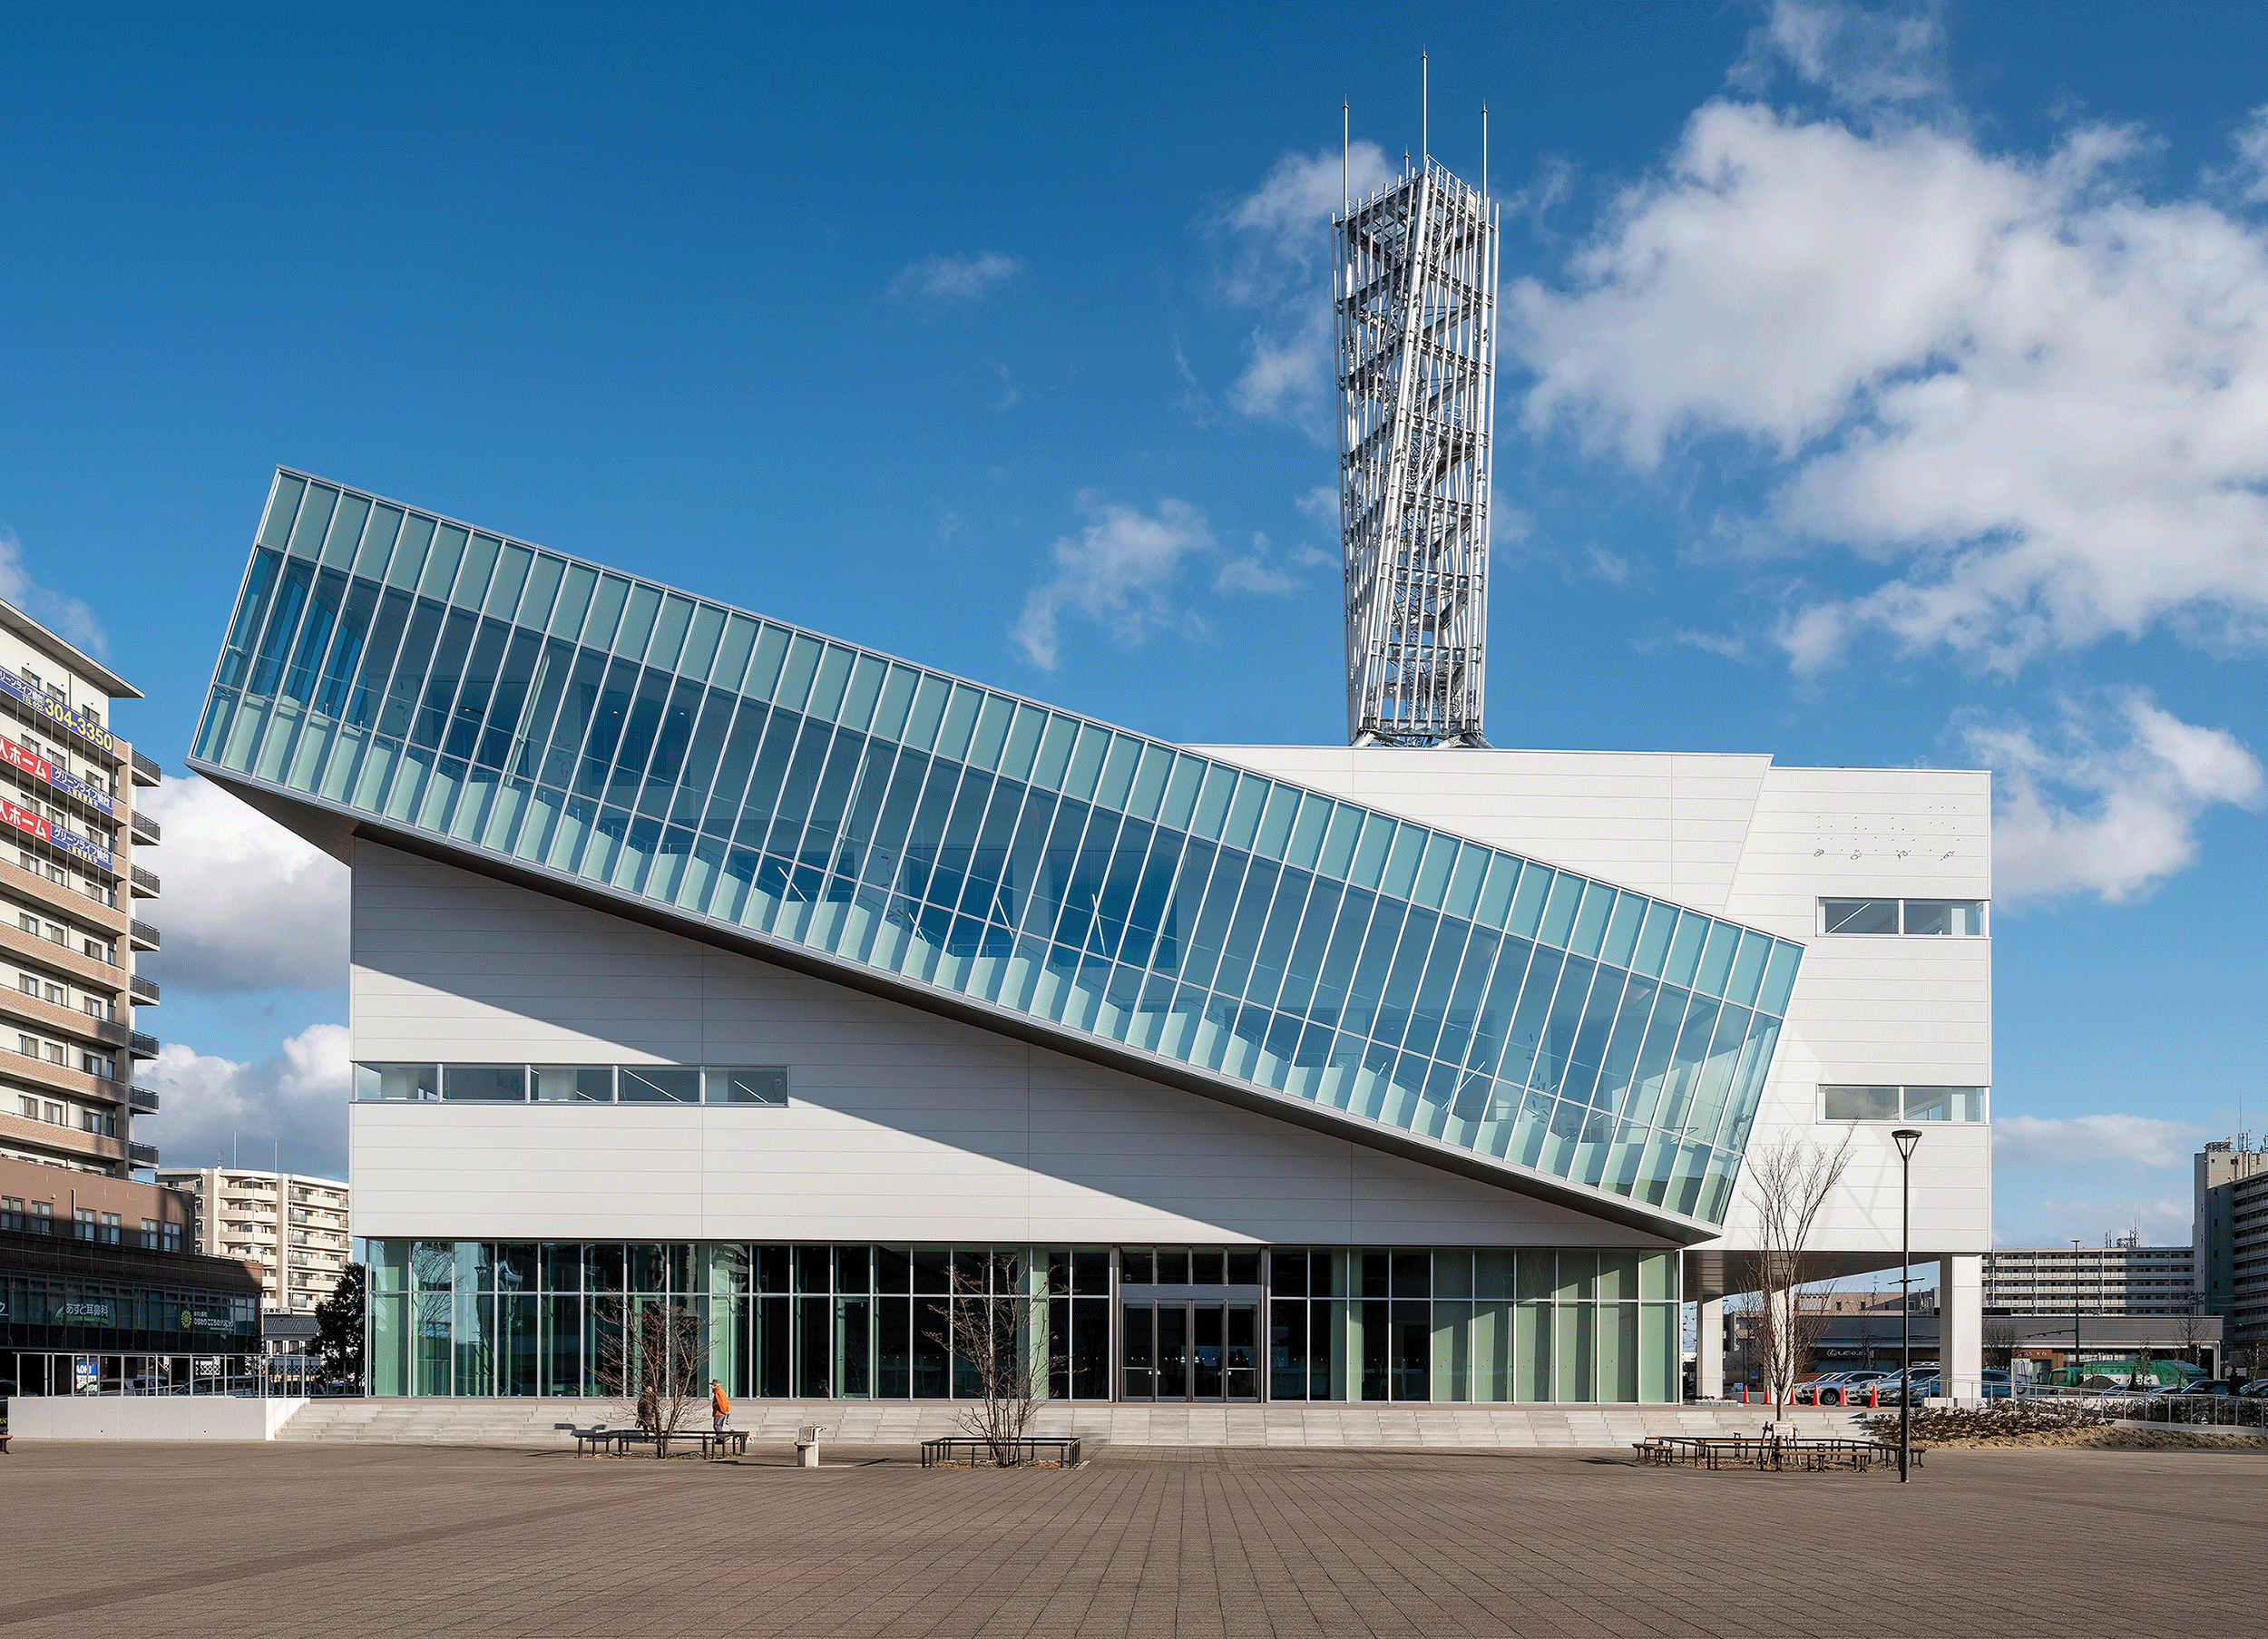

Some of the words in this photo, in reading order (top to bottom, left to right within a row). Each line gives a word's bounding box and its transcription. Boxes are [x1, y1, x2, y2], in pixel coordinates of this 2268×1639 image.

[22, 695, 32, 706] TEL
[54, 769, 109, 807] グリーンライフ仙台
[54, 827, 109, 863] グリーンライフ仙台
[66, 1303, 108, 1316] あすと耳鼻科
